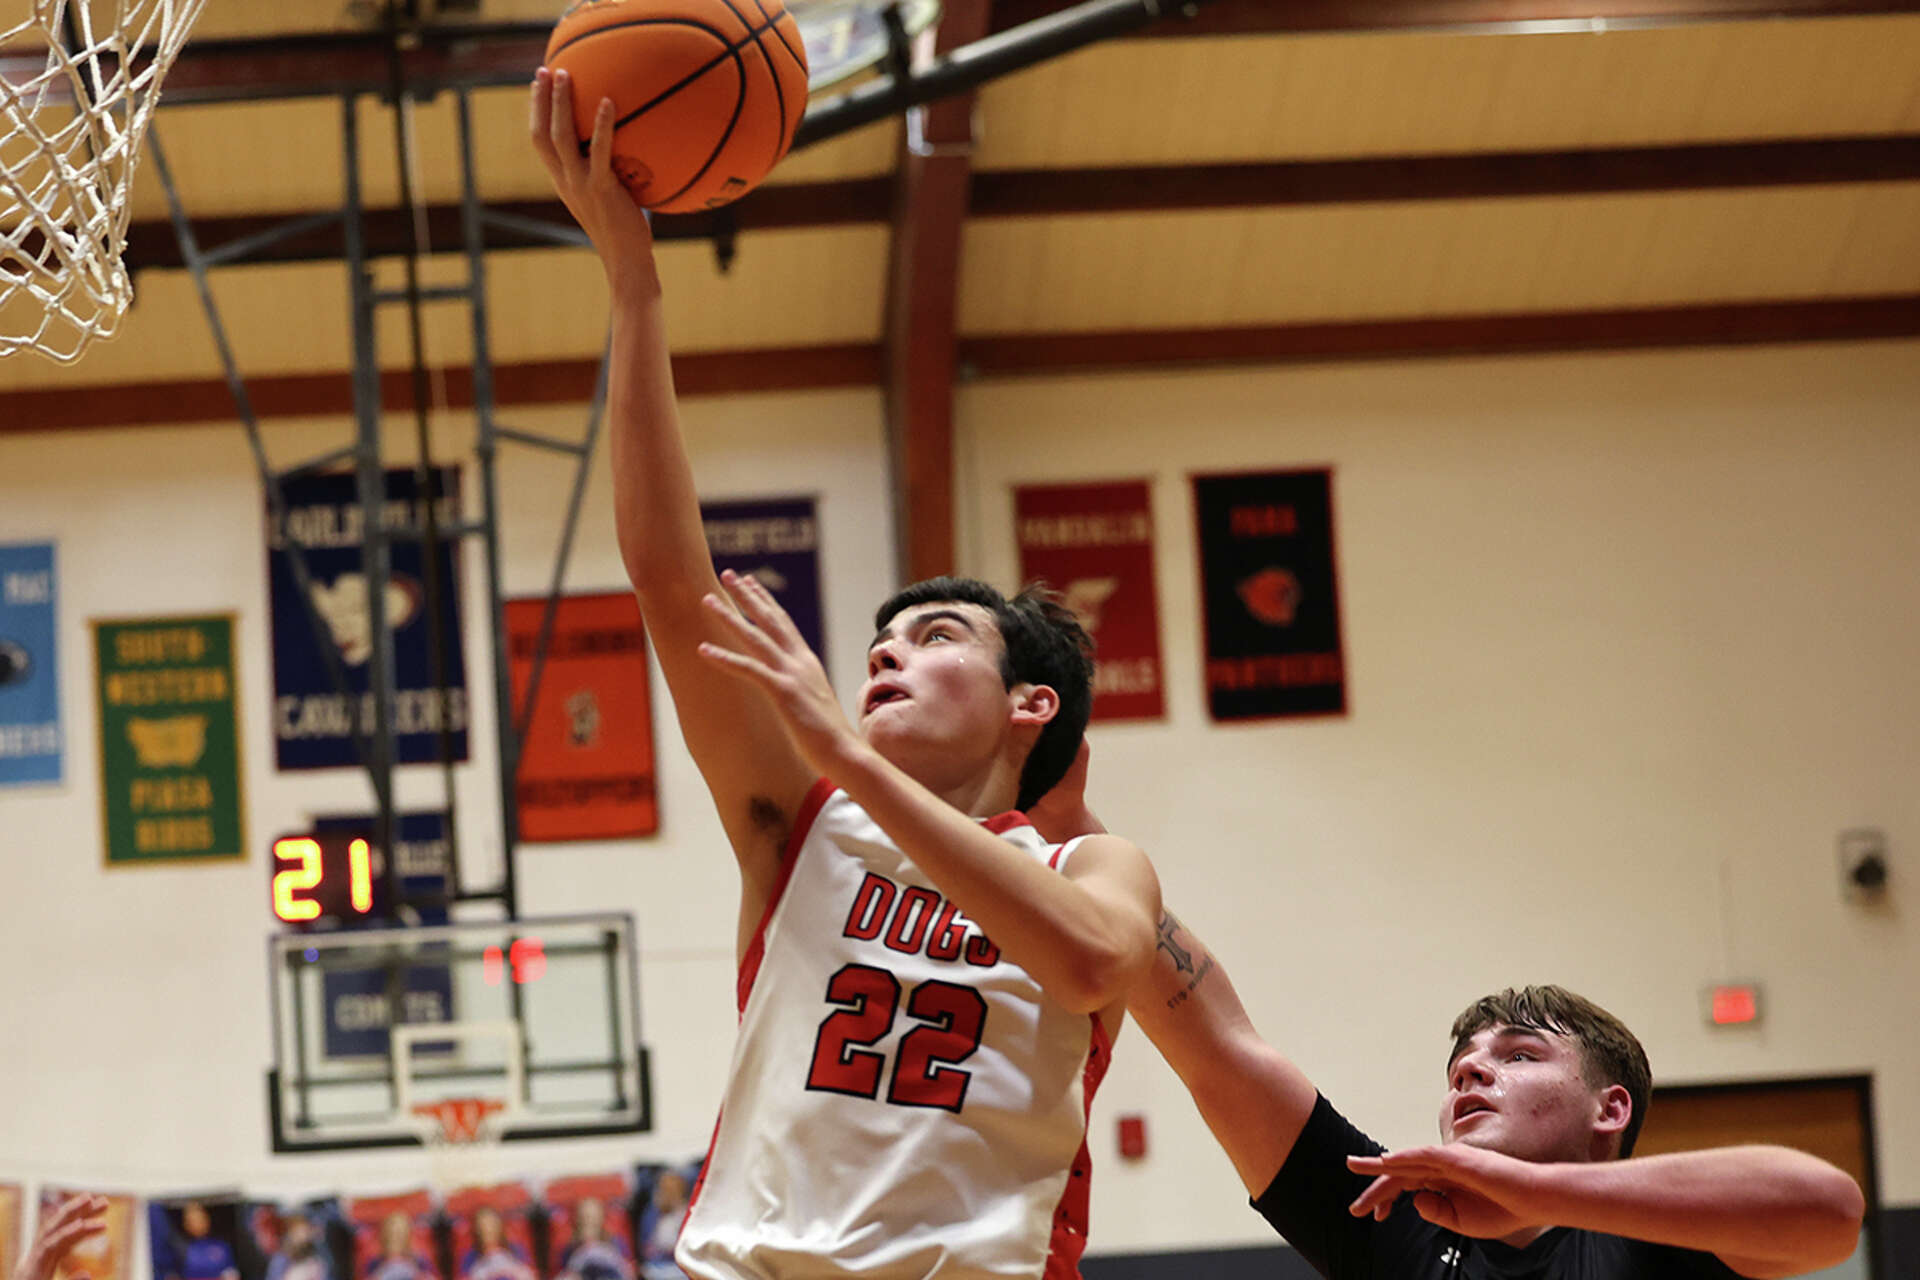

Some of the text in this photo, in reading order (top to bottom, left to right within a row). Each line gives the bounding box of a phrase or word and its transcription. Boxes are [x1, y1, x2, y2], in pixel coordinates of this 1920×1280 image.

[107, 668, 227, 705] WESTERN
[272, 837, 373, 922] 21
[332, 990, 444, 1031] COMTS
[805, 962, 988, 1115] 22
